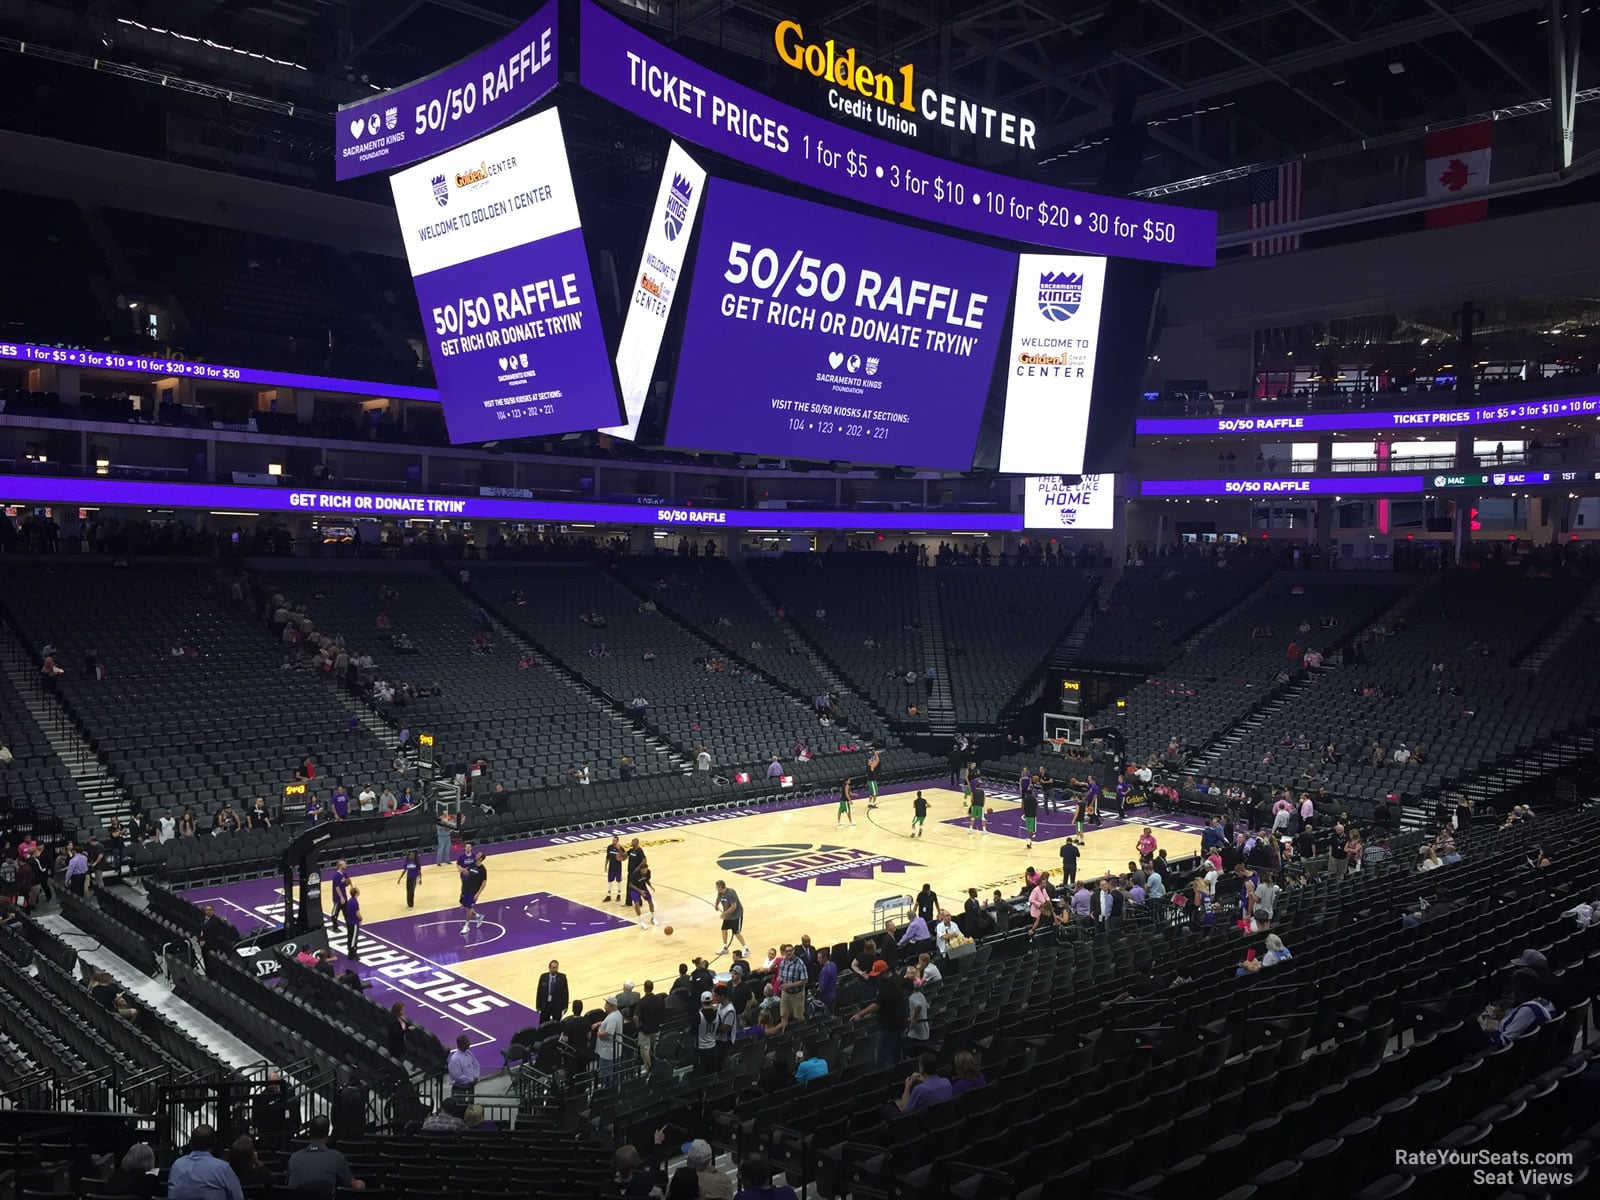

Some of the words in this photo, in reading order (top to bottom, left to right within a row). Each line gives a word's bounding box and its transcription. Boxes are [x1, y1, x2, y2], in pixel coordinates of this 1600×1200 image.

[415, 83, 475, 135] 50/50
[481, 27, 552, 101] RAFFLE
[828, 89, 872, 123] Credit
[876, 108, 917, 138] Union
[921, 88, 1036, 150] CENTER
[342, 137, 385, 158] SACRAMENTO
[386, 131, 405, 147] KINGS
[626, 51, 708, 119] TICKET
[712, 96, 790, 153] PRICES
[802, 135, 810, 160] 1
[817, 140, 842, 169] for
[847, 150, 868, 178] $5
[890, 165, 901, 188] 3
[905, 168, 930, 196] for
[933, 176, 964, 206] $10
[985, 191, 1004, 215] 10
[1009, 196, 1035, 221] for
[1038, 200, 1069, 228] $20
[1088, 212, 1109, 235] 30
[1113, 215, 1138, 238] for
[1142, 217, 1175, 244] $50
[488, 157, 518, 177] CENTER
[418, 217, 459, 242] WELCOME
[459, 213, 471, 229] TO
[471, 201, 507, 224] GOLDEN
[507, 199, 513, 212] 1
[514, 184, 553, 211] CENTER
[666, 195, 687, 222] KINGS
[646, 252, 670, 278] WELCOME
[669, 269, 677, 282] TO
[723, 241, 847, 303] 50/50
[855, 268, 988, 330] RAFFLE
[1038, 291, 1082, 303] KINGS
[432, 296, 491, 336] 50/50
[492, 273, 581, 322] RAFFLE
[635, 289, 667, 319] CENTER
[720, 293, 764, 321] GET
[766, 300, 816, 331] RICH
[819, 311, 847, 336] OR
[850, 316, 922, 349] DONATE
[440, 339, 460, 357] GET
[461, 332, 486, 354] RICH
[486, 330, 502, 348] OR
[501, 320, 545, 345] DONATE
[1021, 337, 1073, 348] WELCOME
[1076, 339, 1089, 348] TO
[25, 347, 31, 358] 1
[35, 350, 50, 360] for
[52, 351, 67, 362] $5
[79, 353, 86, 363] 3
[88, 354, 103, 365] for
[105, 355, 125, 368] $10
[136, 359, 148, 370] 10
[149, 360, 163, 371] for
[166, 362, 184, 374] $20
[193, 365, 205, 375] 30
[207, 366, 220, 377] for
[222, 369, 240, 379] $50
[1016, 366, 1085, 378] CENTER
[816, 372, 862, 387] SACRAMENTO
[862, 379, 882, 390] KINGS
[832, 385, 864, 395] FOUNDATION
[771, 398, 793, 410] VISIT
[793, 401, 810, 413] THE
[810, 404, 833, 415] 50/50
[833, 406, 861, 418] KIOSKS
[861, 409, 873, 419] AT
[872, 410, 910, 423] SECTIONS:
[1393, 414, 1431, 424] TICKET
[1431, 412, 1470, 423] PRICES
[1475, 411, 1480, 420] 1
[1482, 409, 1495, 420] for
[1497, 407, 1509, 419] $5
[1518, 406, 1524, 416] 3
[1526, 405, 1539, 415] for
[1541, 403, 1559, 414] $10
[1569, 401, 1581, 411] 10
[1582, 400, 1596, 410] for
[788, 418, 805, 431] 104
[817, 421, 834, 434] 123
[846, 424, 863, 437] 202
[873, 427, 889, 440] 221
[1218, 418, 1254, 431] 50/50
[1256, 418, 1304, 429] RAFFLE
[1038, 483, 1072, 493] PLACE
[1075, 482, 1100, 491] LIKE
[1225, 481, 1261, 493] 50/50
[1263, 481, 1310, 491] RAFFLE
[1447, 477, 1465, 485] MAC
[1508, 474, 1525, 482] SAC
[1562, 472, 1577, 480] 1ST
[289, 493, 316, 508] GET
[319, 494, 352, 509] RICH
[354, 495, 374, 510] OR
[375, 496, 424, 512] DONATE
[1044, 491, 1092, 506] HOME
[657, 510, 687, 522] 50/50
[689, 511, 726, 523] RAFFLE
[732, 847, 880, 879] KINGS
[767, 855, 893, 884] SACRAMENTO
